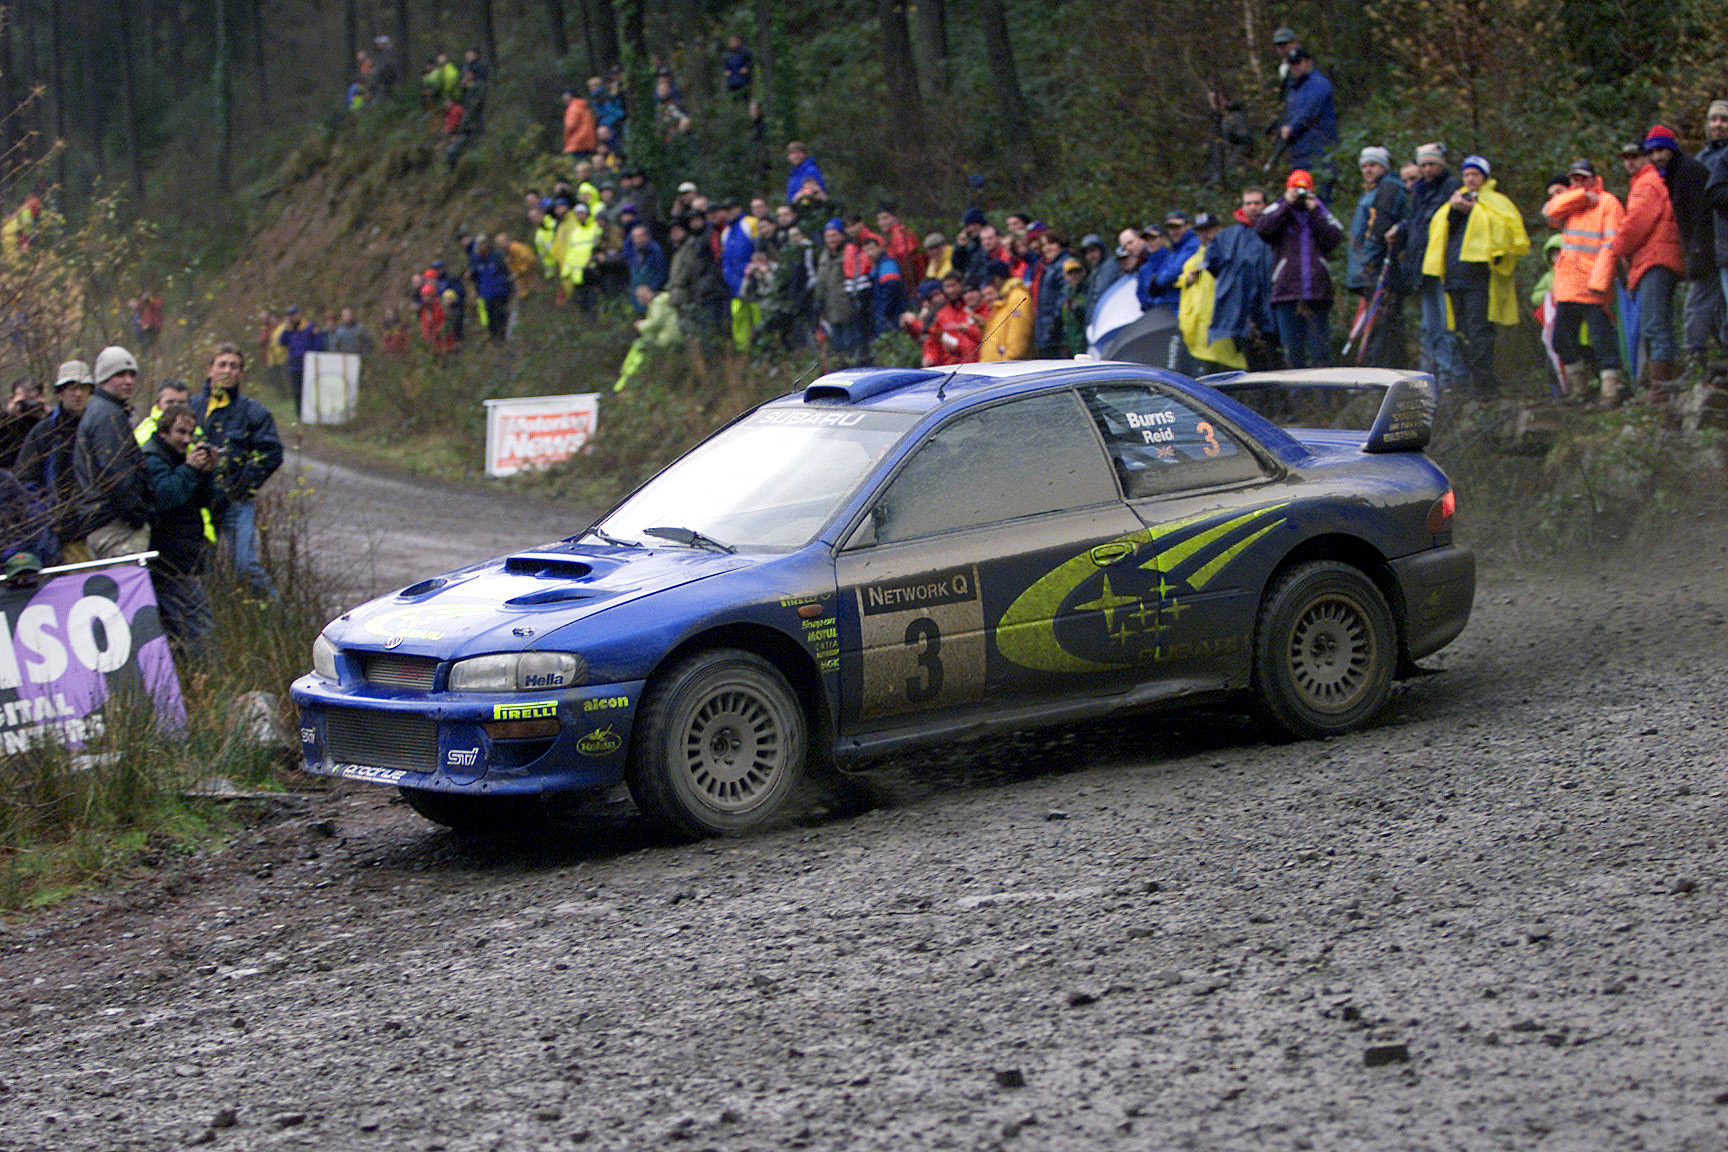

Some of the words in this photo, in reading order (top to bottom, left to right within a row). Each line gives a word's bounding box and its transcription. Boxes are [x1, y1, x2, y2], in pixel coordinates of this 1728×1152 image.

[756, 410, 866, 426] SUBARU
[1126, 410, 1176, 429] Burns
[1142, 427, 1175, 444] Reid
[1196, 421, 1220, 457] 3
[952, 574, 968, 595] Q
[904, 617, 945, 703] 3
[525, 673, 564, 687] Hella
[493, 700, 558, 719] PIRELLI
[583, 696, 629, 711] alcon
